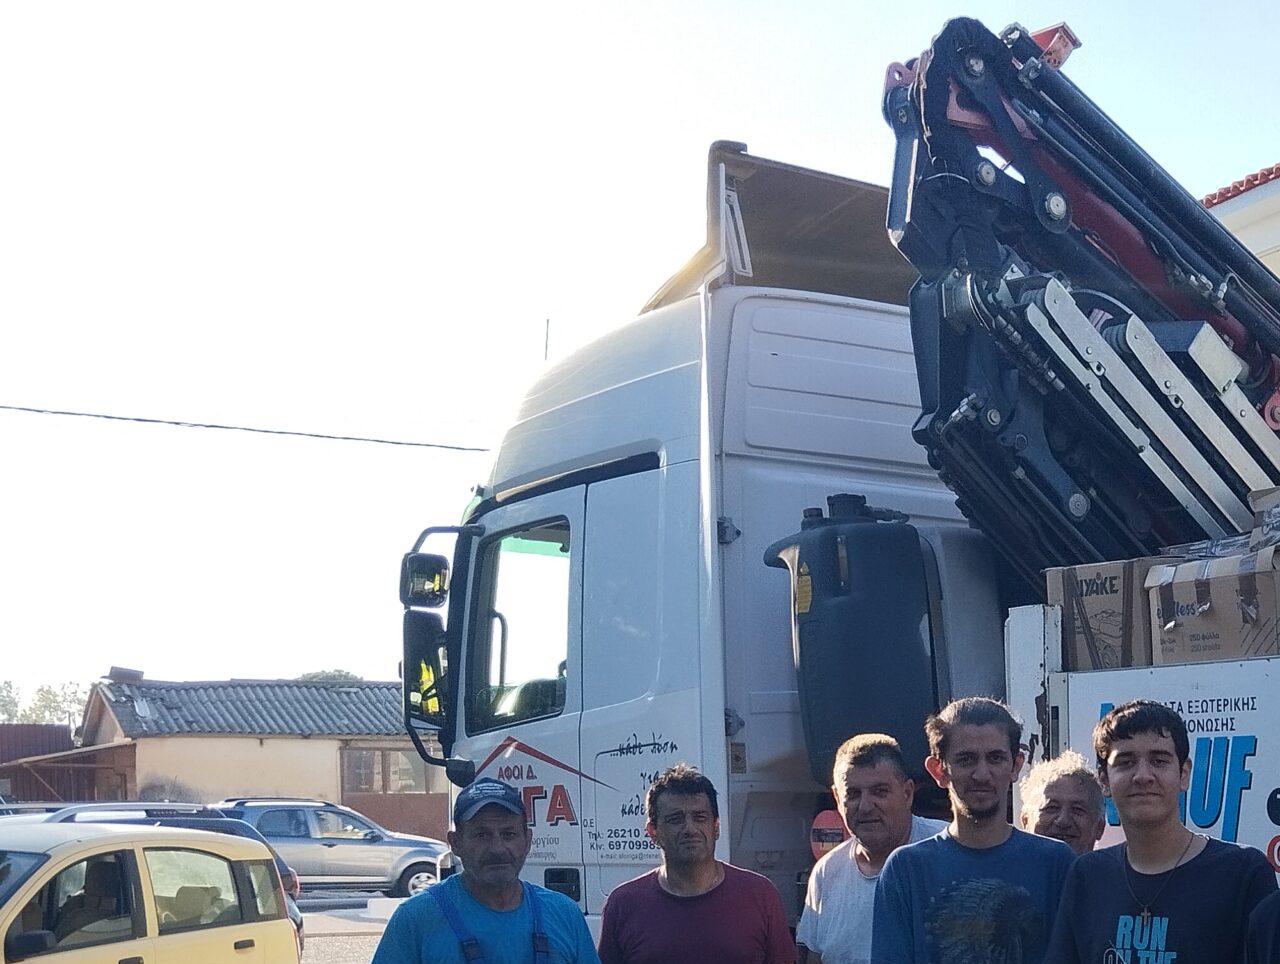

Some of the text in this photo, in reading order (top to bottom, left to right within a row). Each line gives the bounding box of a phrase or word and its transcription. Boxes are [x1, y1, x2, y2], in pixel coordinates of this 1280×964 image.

[1187, 697, 1257, 714] ΕΞΩΤΕΡΙΚΗΣ
[1184, 717, 1236, 733] ΟΝΩΣΗΣ
[607, 828, 640, 839] 26210
[1115, 915, 1169, 951] RUN
